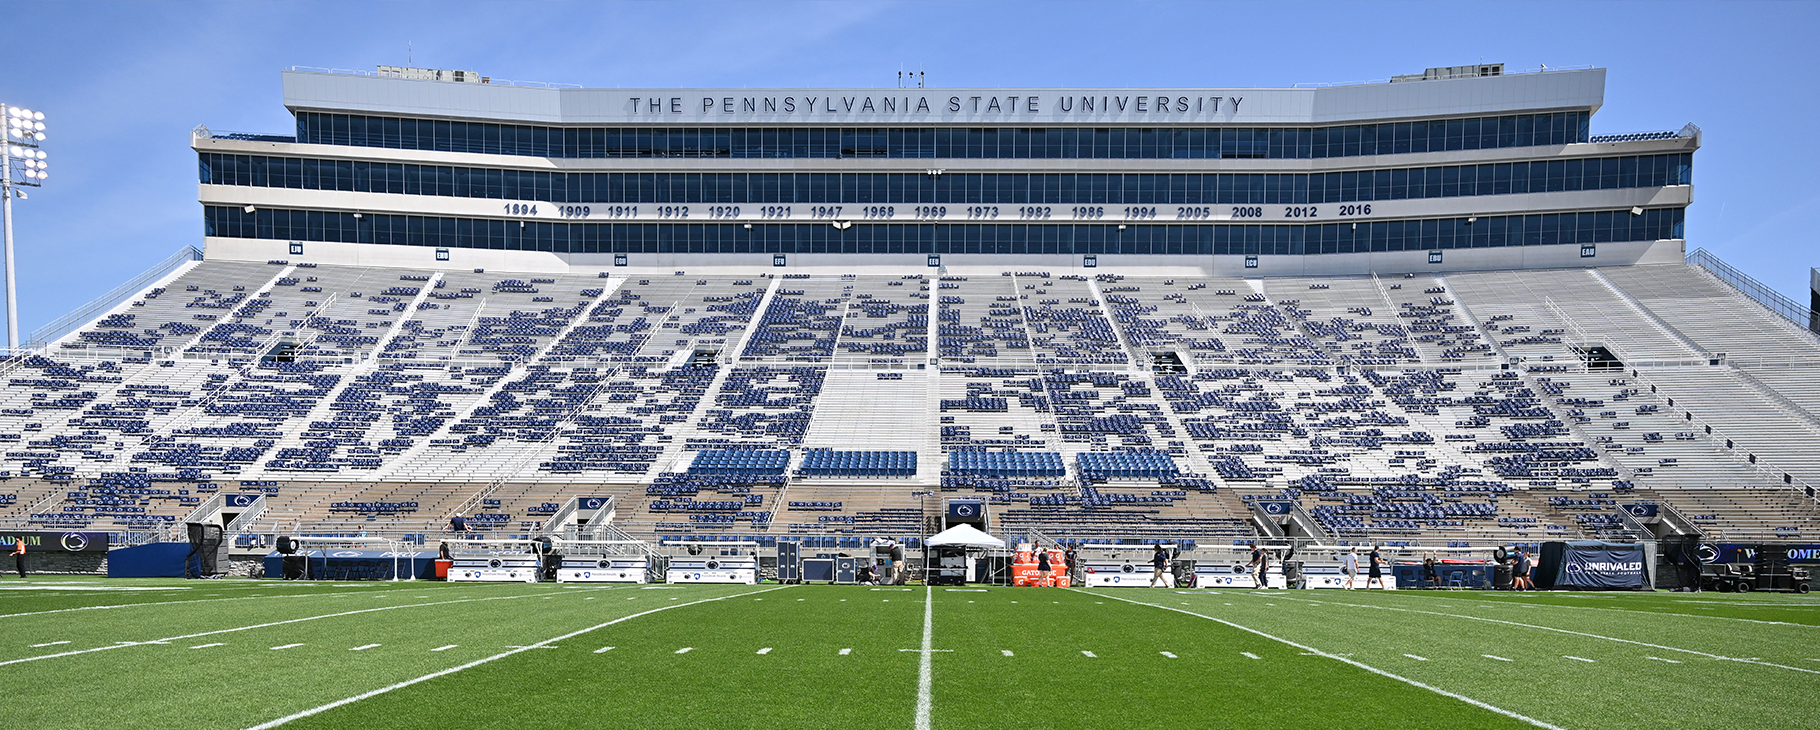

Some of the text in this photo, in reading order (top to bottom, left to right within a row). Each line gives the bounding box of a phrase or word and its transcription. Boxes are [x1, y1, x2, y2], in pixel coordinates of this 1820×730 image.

[630, 96, 1244, 113] THE PENNSYLVANIA STATE UNIVERSITY
[504, 203, 1371, 218] 1894 1909 1911 1912 1920 1921 1947 1968 1969 1973 1982 1986 1994 2005 2008 2012 2016
[1585, 561, 1642, 571] UNRIVALED
